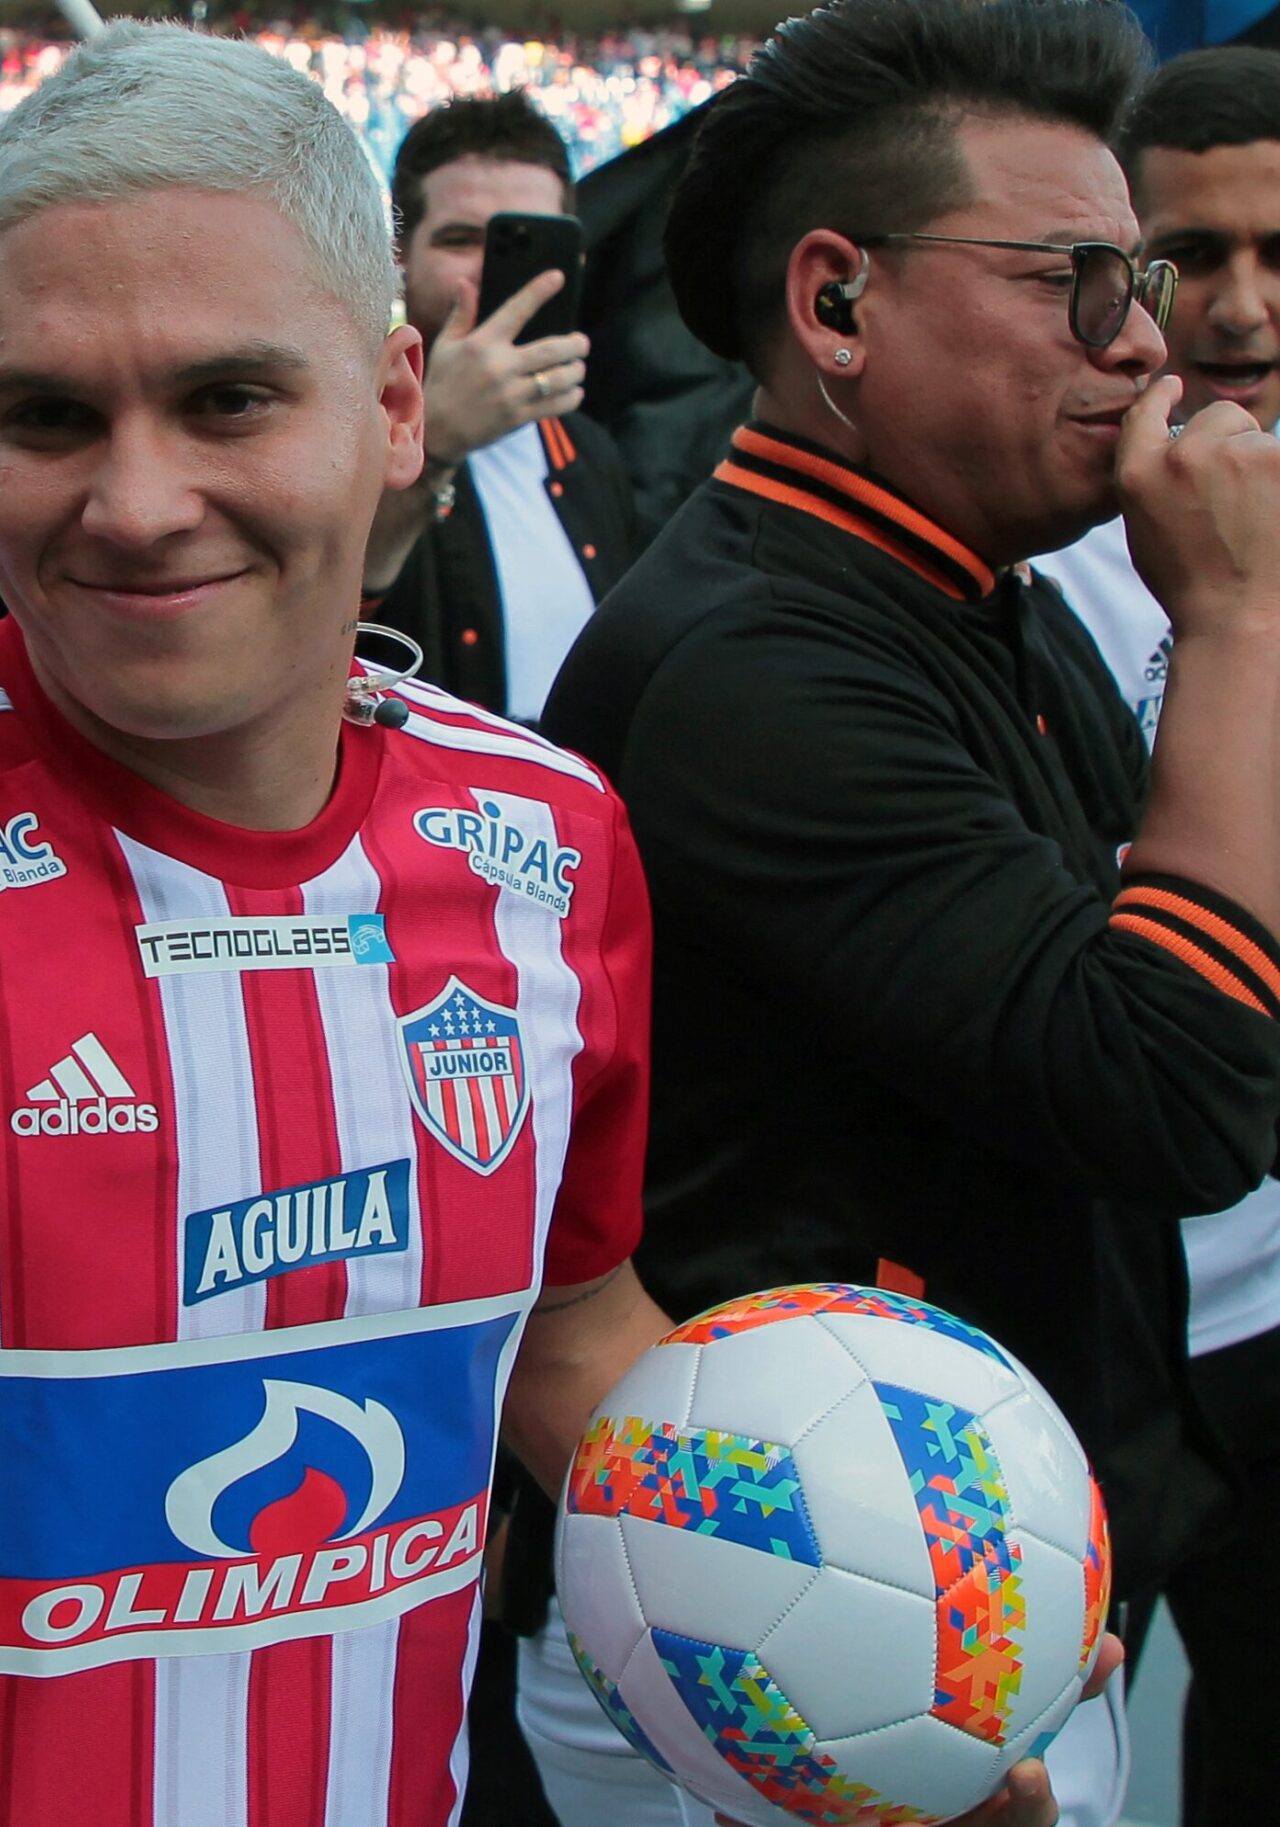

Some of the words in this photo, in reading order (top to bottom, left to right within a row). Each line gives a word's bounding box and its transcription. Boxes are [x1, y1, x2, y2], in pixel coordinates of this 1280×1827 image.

[3, 860, 60, 884] Blanda
[472, 854, 521, 890] Cápsula
[526, 881, 567, 913] Blanda
[429, 1052, 509, 1077] JUNIOR
[10, 1097, 160, 1136] adidas
[195, 1169, 398, 1295] AGUILA
[21, 1503, 479, 1643] OLIMPICA
